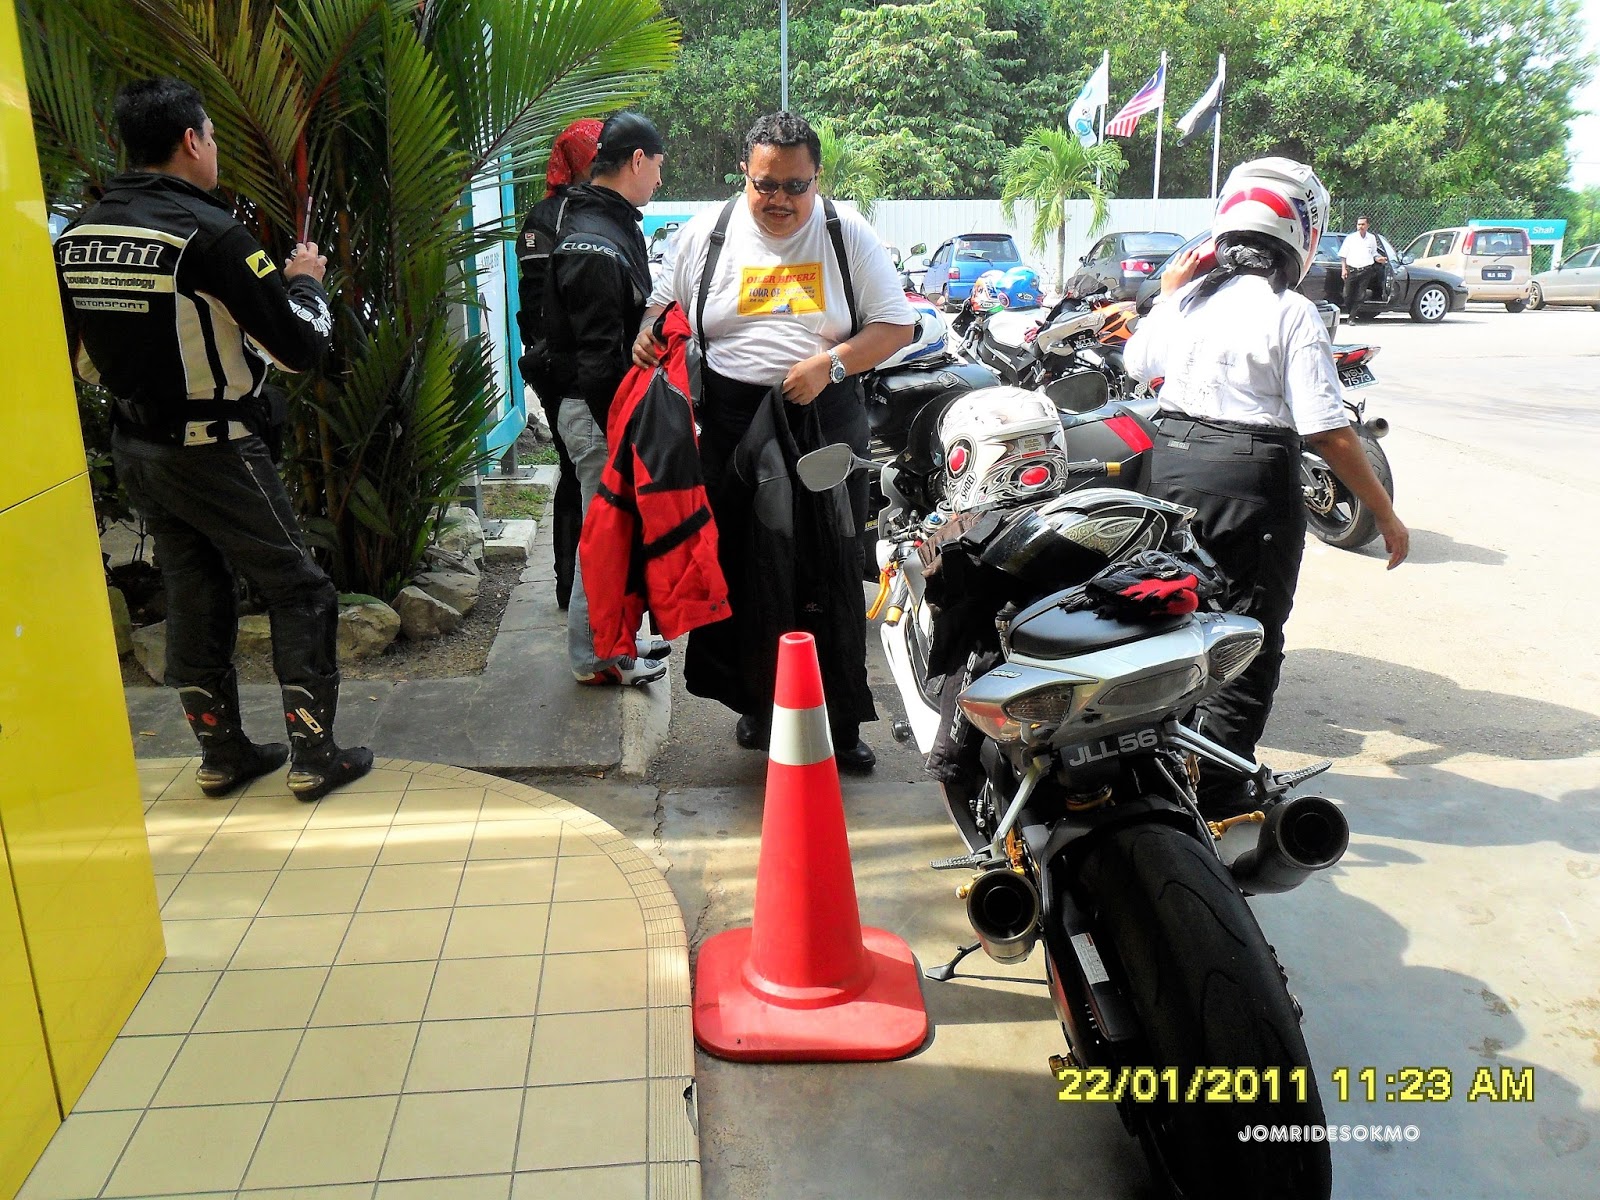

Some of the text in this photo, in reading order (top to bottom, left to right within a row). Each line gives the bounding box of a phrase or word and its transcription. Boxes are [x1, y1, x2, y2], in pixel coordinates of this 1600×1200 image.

[748, 288, 769, 297] TOUR
[75, 300, 145, 309] MOTORSPORT
[1343, 373, 1372, 386] 7573
[960, 474, 975, 499] SHOEI
[1069, 728, 1158, 767] JLL 56
